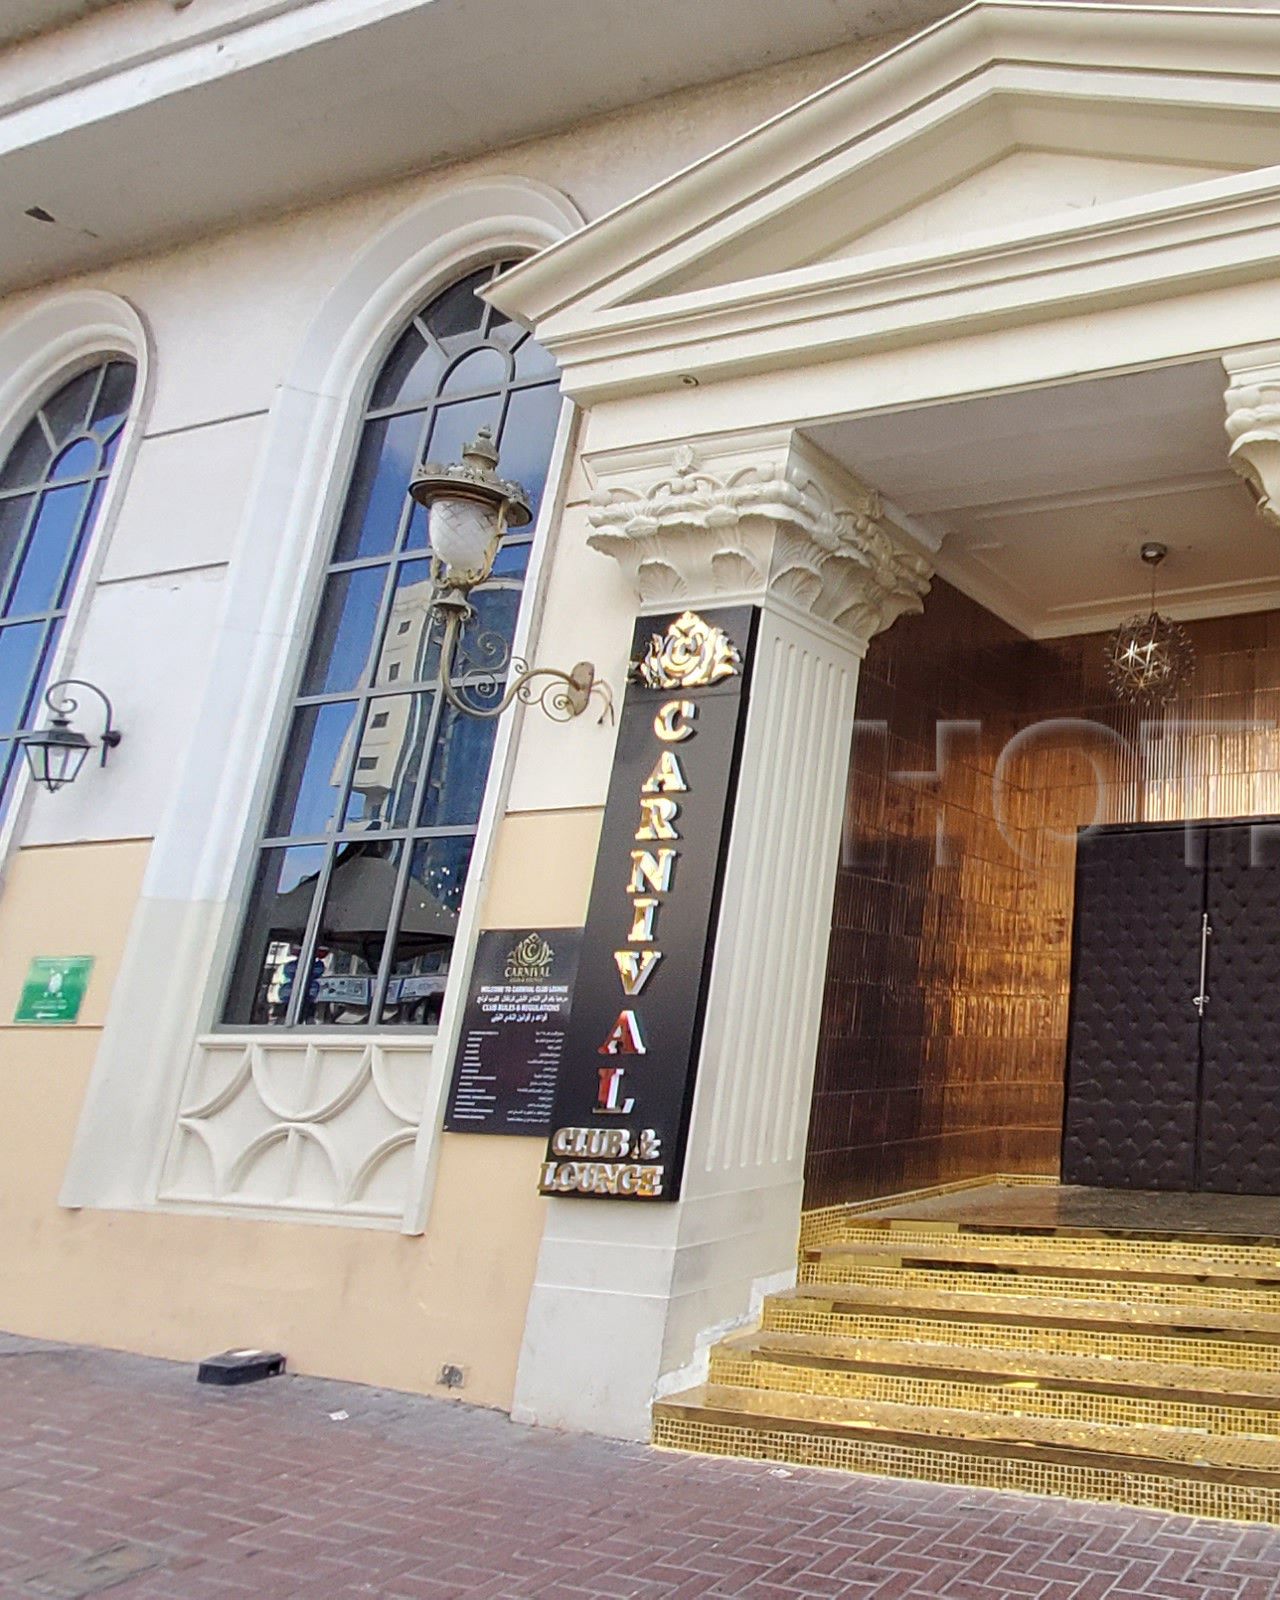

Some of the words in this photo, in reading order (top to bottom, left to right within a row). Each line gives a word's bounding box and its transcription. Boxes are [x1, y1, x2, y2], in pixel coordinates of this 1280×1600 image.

[592, 700, 697, 1114] CARNIVAL
[504, 966, 551, 977] CARNIVAL
[552, 1126, 631, 1159] CLUB
[631, 1128, 662, 1160] &
[538, 1161, 664, 1197] LOUNGE
